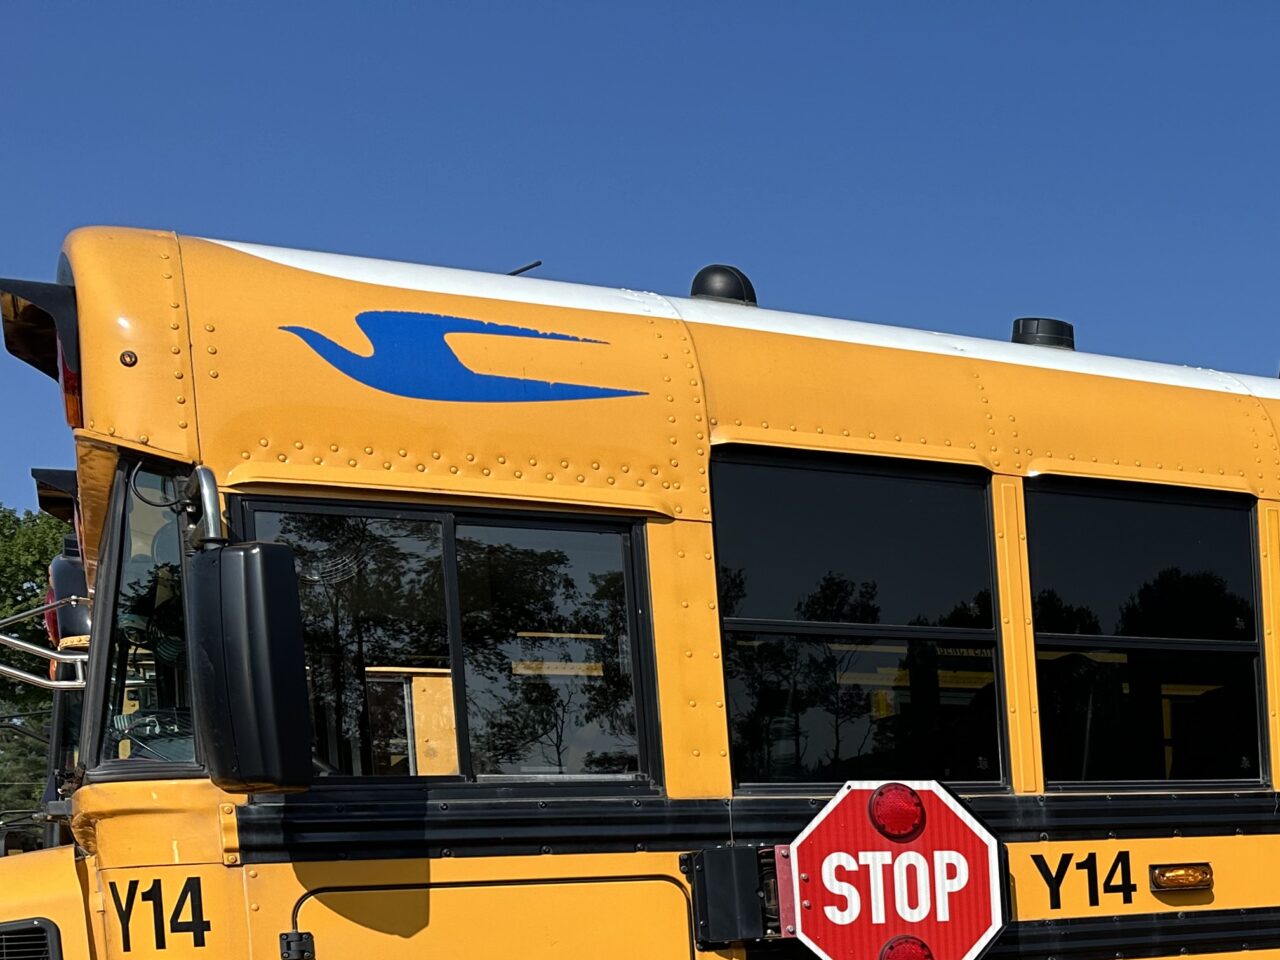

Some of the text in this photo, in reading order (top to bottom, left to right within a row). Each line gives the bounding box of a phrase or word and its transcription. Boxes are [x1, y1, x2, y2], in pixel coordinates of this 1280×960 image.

[108, 876, 212, 953] Y14
[821, 850, 969, 925] STOP
[1030, 850, 1137, 910] Y14
